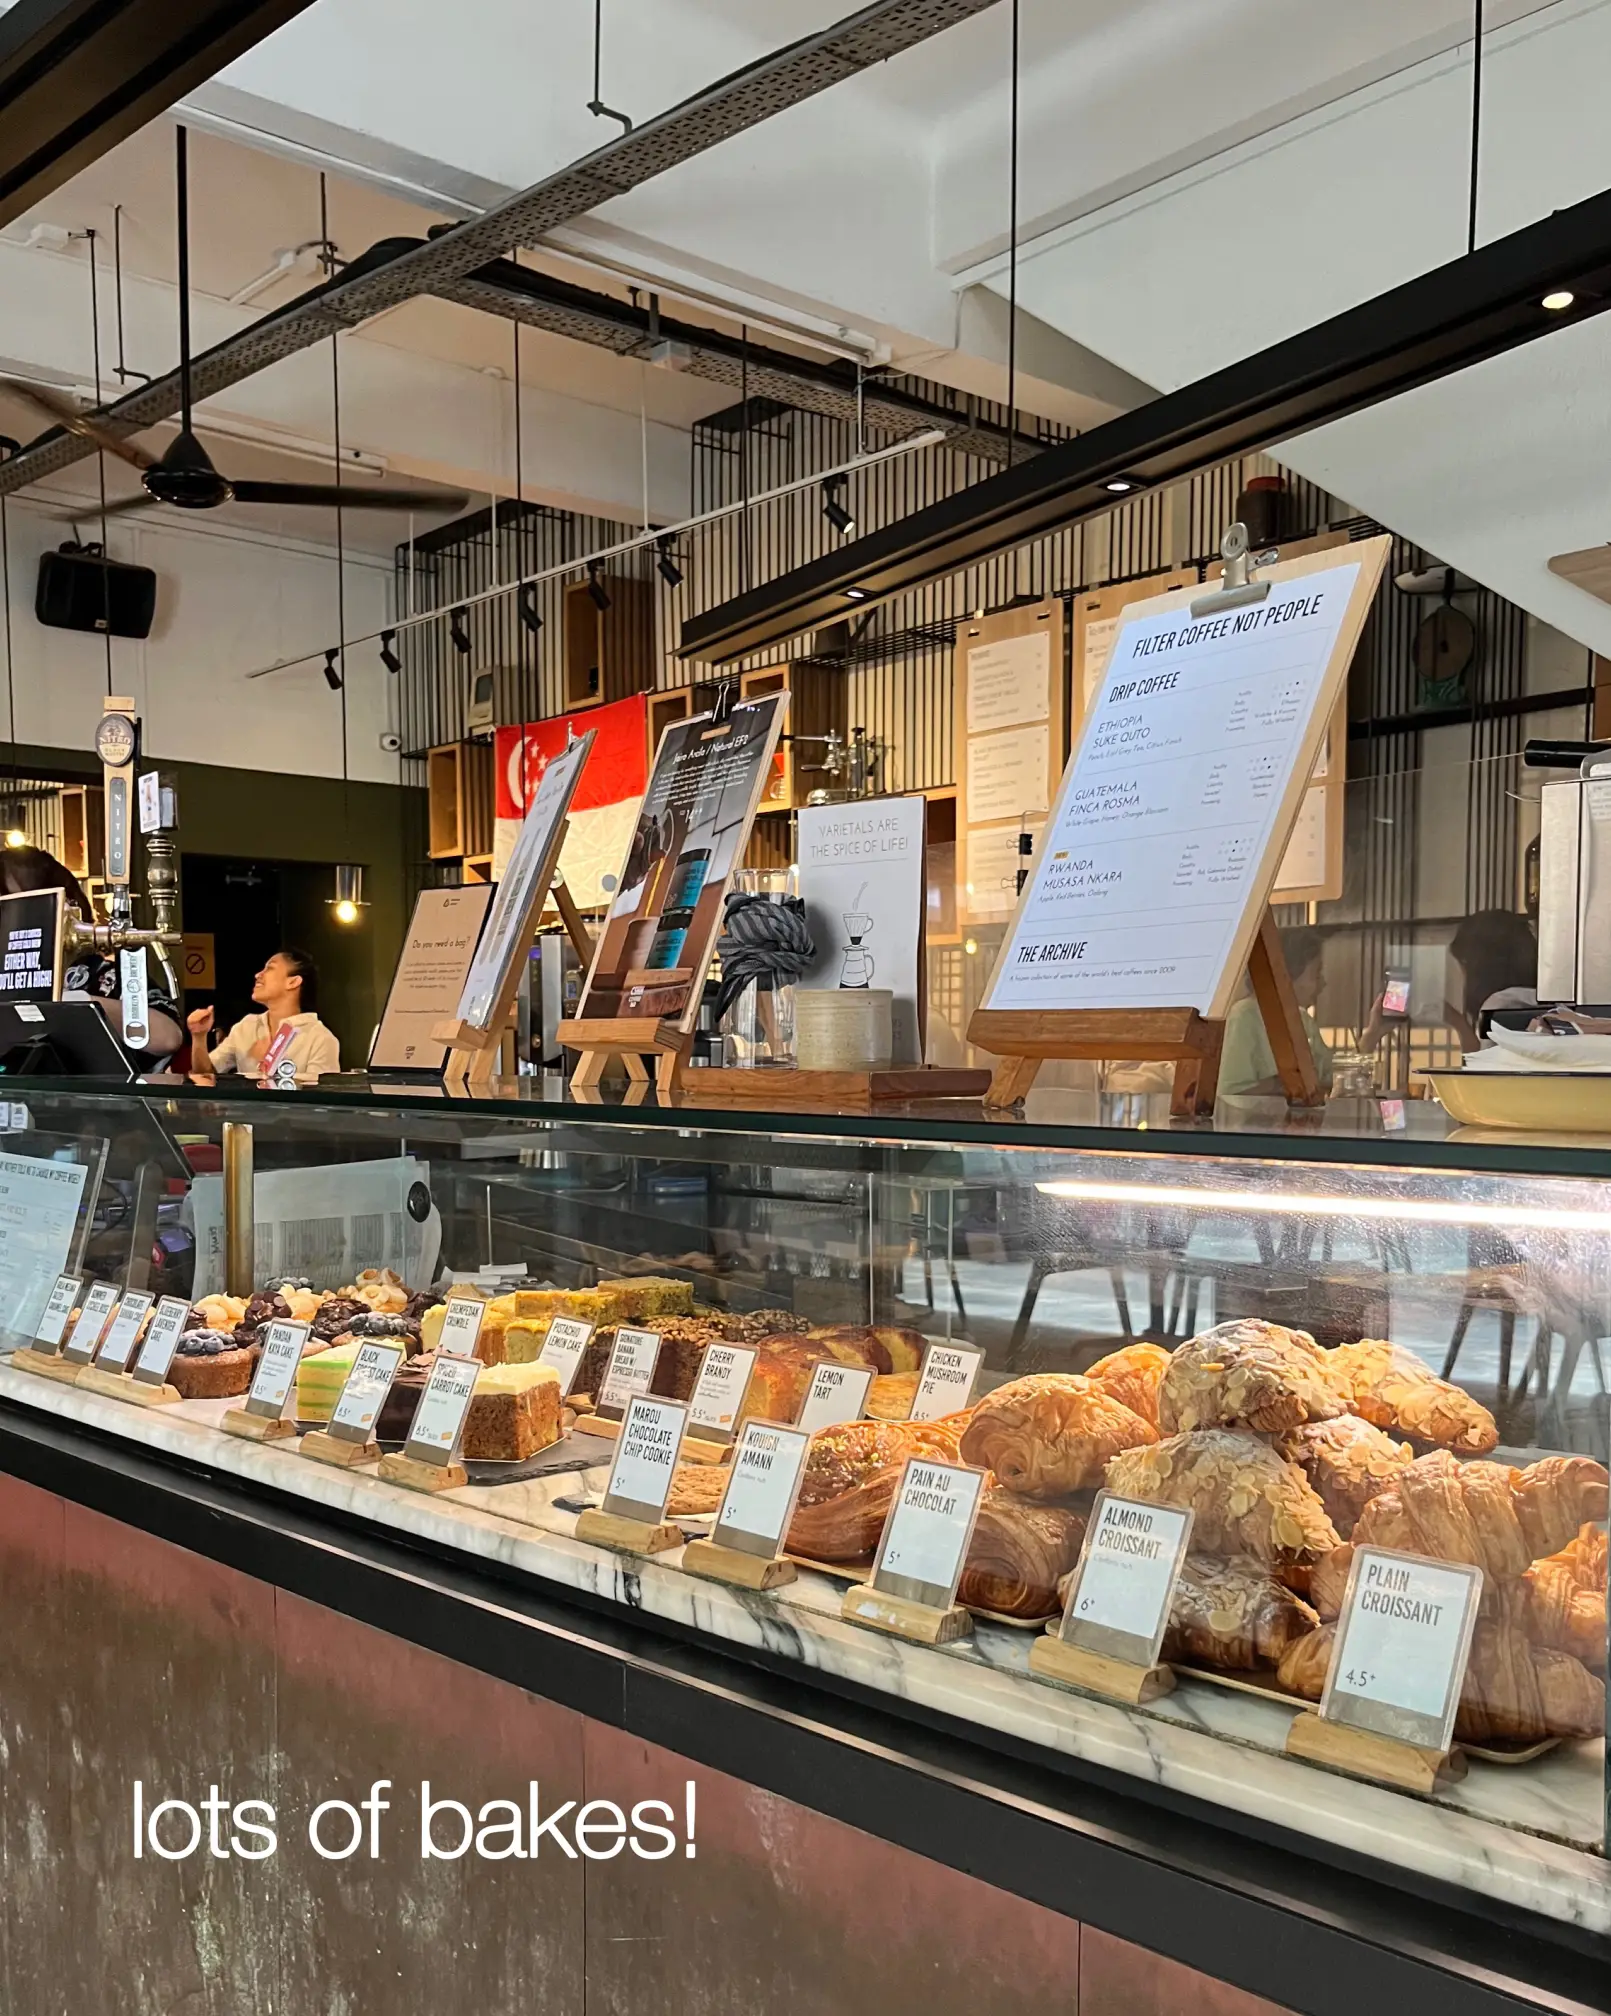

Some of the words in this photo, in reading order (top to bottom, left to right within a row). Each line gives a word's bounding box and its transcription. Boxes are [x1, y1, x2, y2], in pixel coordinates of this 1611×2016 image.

[1132, 632, 1176, 658] FILTER
[1178, 618, 1231, 647] COFFEE
[1232, 610, 1264, 634] NOT
[1264, 594, 1324, 627] PEOPLE
[1109, 682, 1135, 703] DRIP
[1136, 672, 1180, 696] COFFEE
[1098, 714, 1143, 733] ETHIOPIA
[711, 740, 734, 754] Natural
[1093, 734, 1119, 748] SUKE
[1120, 727, 1150, 743] QUTO
[1075, 781, 1138, 801] GUATEMALA
[1069, 801, 1100, 816] FINCA
[1103, 796, 1140, 811] ROSMA
[114, 794, 122, 859] NITRO
[818, 820, 874, 837] VARIETALS
[877, 818, 899, 832] ARE
[810, 844, 830, 859] THE
[833, 841, 860, 856] SPICE
[862, 839, 877, 854] OF
[881, 836, 908, 852] LIFE!
[1048, 860, 1093, 875] RWANDA
[1043, 878, 1084, 891] MUSASA
[1086, 871, 1123, 886] NKARA
[412, 940, 421, 949] Do
[422, 941, 433, 949] you
[434, 938, 448, 948] need
[454, 936, 471, 950] bag?
[1017, 945, 1040, 964] THE
[1038, 941, 1088, 962] ARCHIVE
[4, 952, 26, 971] EITHER
[26, 951, 41, 970] WAY,
[15, 972, 28, 989] GET
[27, 971, 32, 988] A
[33, 970, 52, 988] HIGH!
[1074, 972, 1081, 980] of
[1091, 970, 1109, 978] world's
[1123, 968, 1142, 976] coffees
[450, 1303, 480, 1317] CHEMPEDAK
[446, 1316, 470, 1330] CRUMBLE
[552, 1322, 581, 1337] PISTACHIO
[151, 1330, 163, 1342] CAKE
[272, 1328, 292, 1344] PANDAN
[548, 1334, 566, 1348] LEMON
[566, 1340, 583, 1352] CAKE
[268, 1343, 280, 1355] KAYA
[280, 1346, 294, 1359] CAKE
[360, 1349, 381, 1364] BLACK
[616, 1345, 634, 1355] BANANA
[709, 1350, 736, 1365] CHERRY
[930, 1351, 962, 1368] CHICKEN
[374, 1367, 392, 1384] CAKE
[704, 1364, 732, 1380] BRANDY
[818, 1369, 844, 1386] LEMON
[926, 1366, 968, 1386] MUSHROOM
[430, 1378, 454, 1394] CARROT
[454, 1382, 470, 1398] CAKE
[813, 1386, 832, 1400] TART
[922, 1380, 935, 1394] PIE
[632, 1406, 662, 1424] MAROU
[628, 1423, 672, 1446] CHOCOLATE
[748, 1431, 780, 1452] KOUIGN
[624, 1441, 642, 1458] CHIP
[642, 1446, 672, 1466] COOKIE
[741, 1450, 774, 1471] AMANN
[910, 1468, 935, 1489] PAIN
[935, 1474, 951, 1492] AU
[904, 1488, 957, 1516] CHOCOLAT
[1103, 1506, 1153, 1533] ALMOND
[1098, 1528, 1162, 1560] CROISSANT
[1366, 1564, 1410, 1592] PLAIN
[1361, 1590, 1443, 1626] CROISSANT
